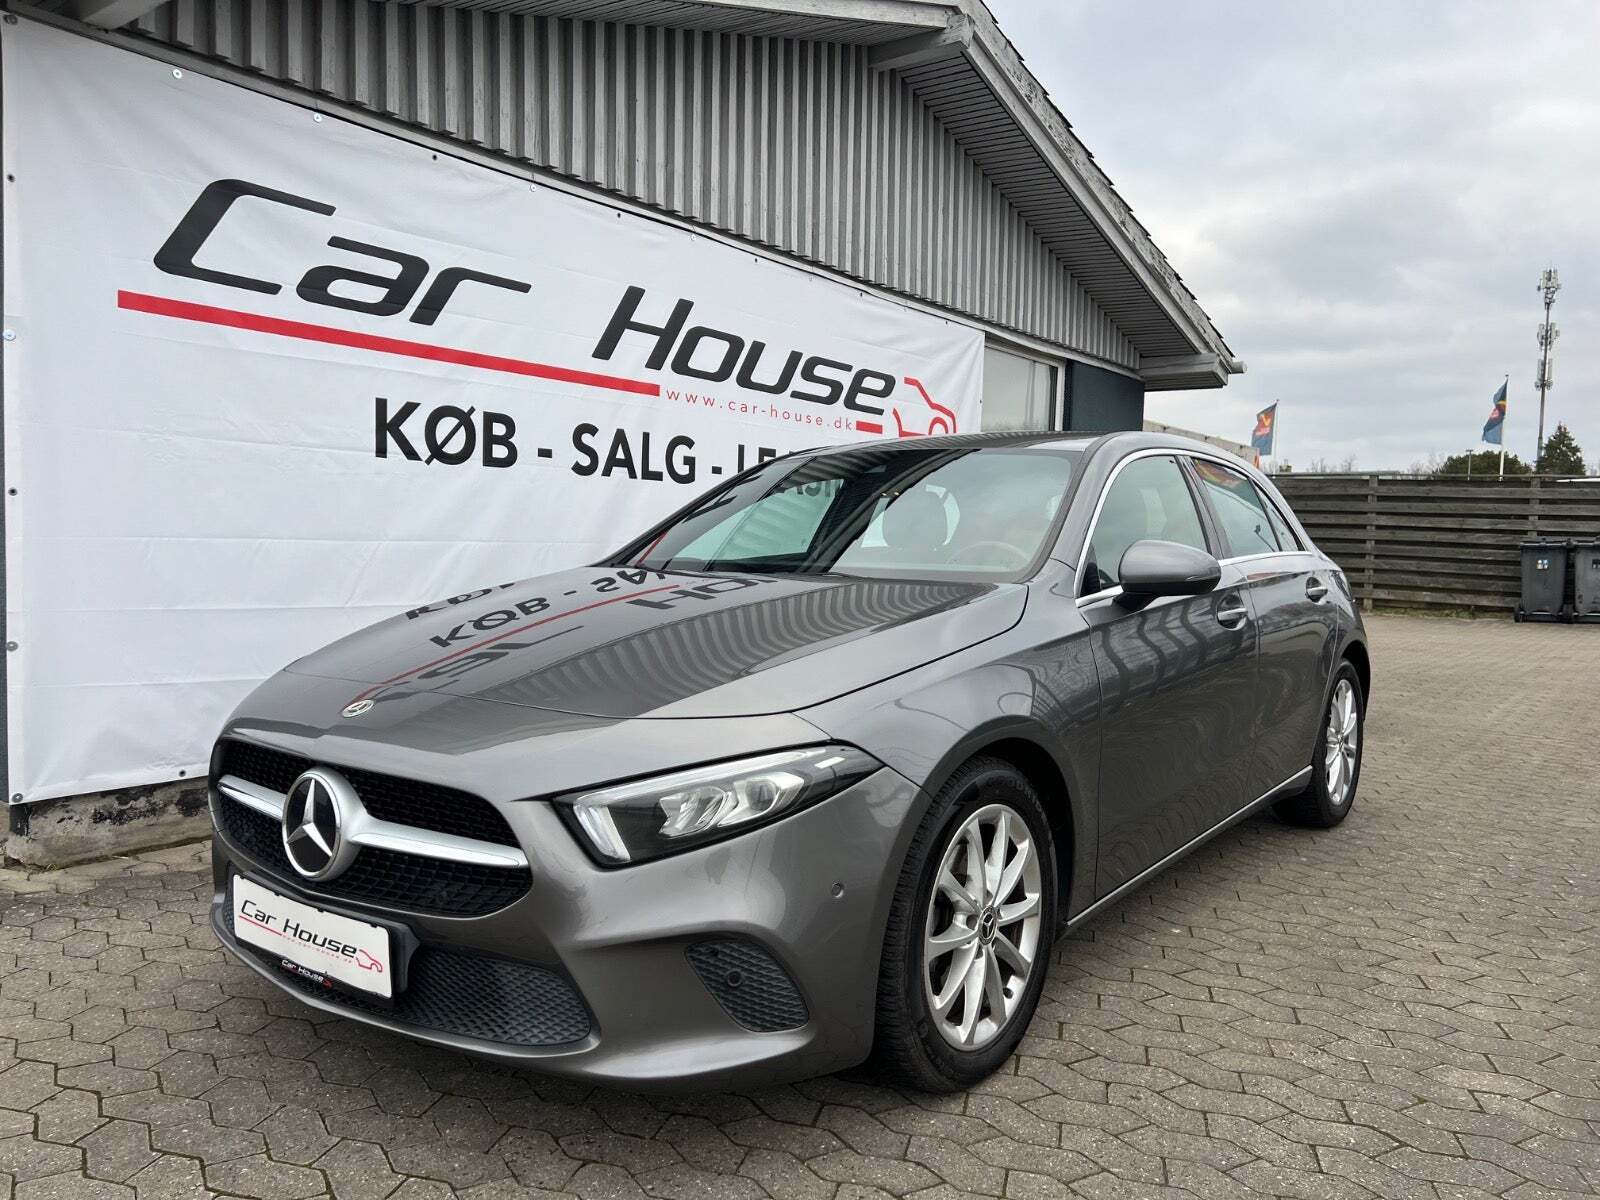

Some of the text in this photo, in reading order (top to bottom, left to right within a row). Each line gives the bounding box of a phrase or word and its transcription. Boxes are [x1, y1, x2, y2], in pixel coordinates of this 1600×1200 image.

[154, 179, 896, 416] Car House
[666, 389, 853, 431] www.car-house.dk
[376, 398, 518, 469] KØB
[572, 423, 696, 485] SALG
[241, 899, 277, 925] Car
[282, 918, 357, 959] House
[281, 959, 297, 970] Car
